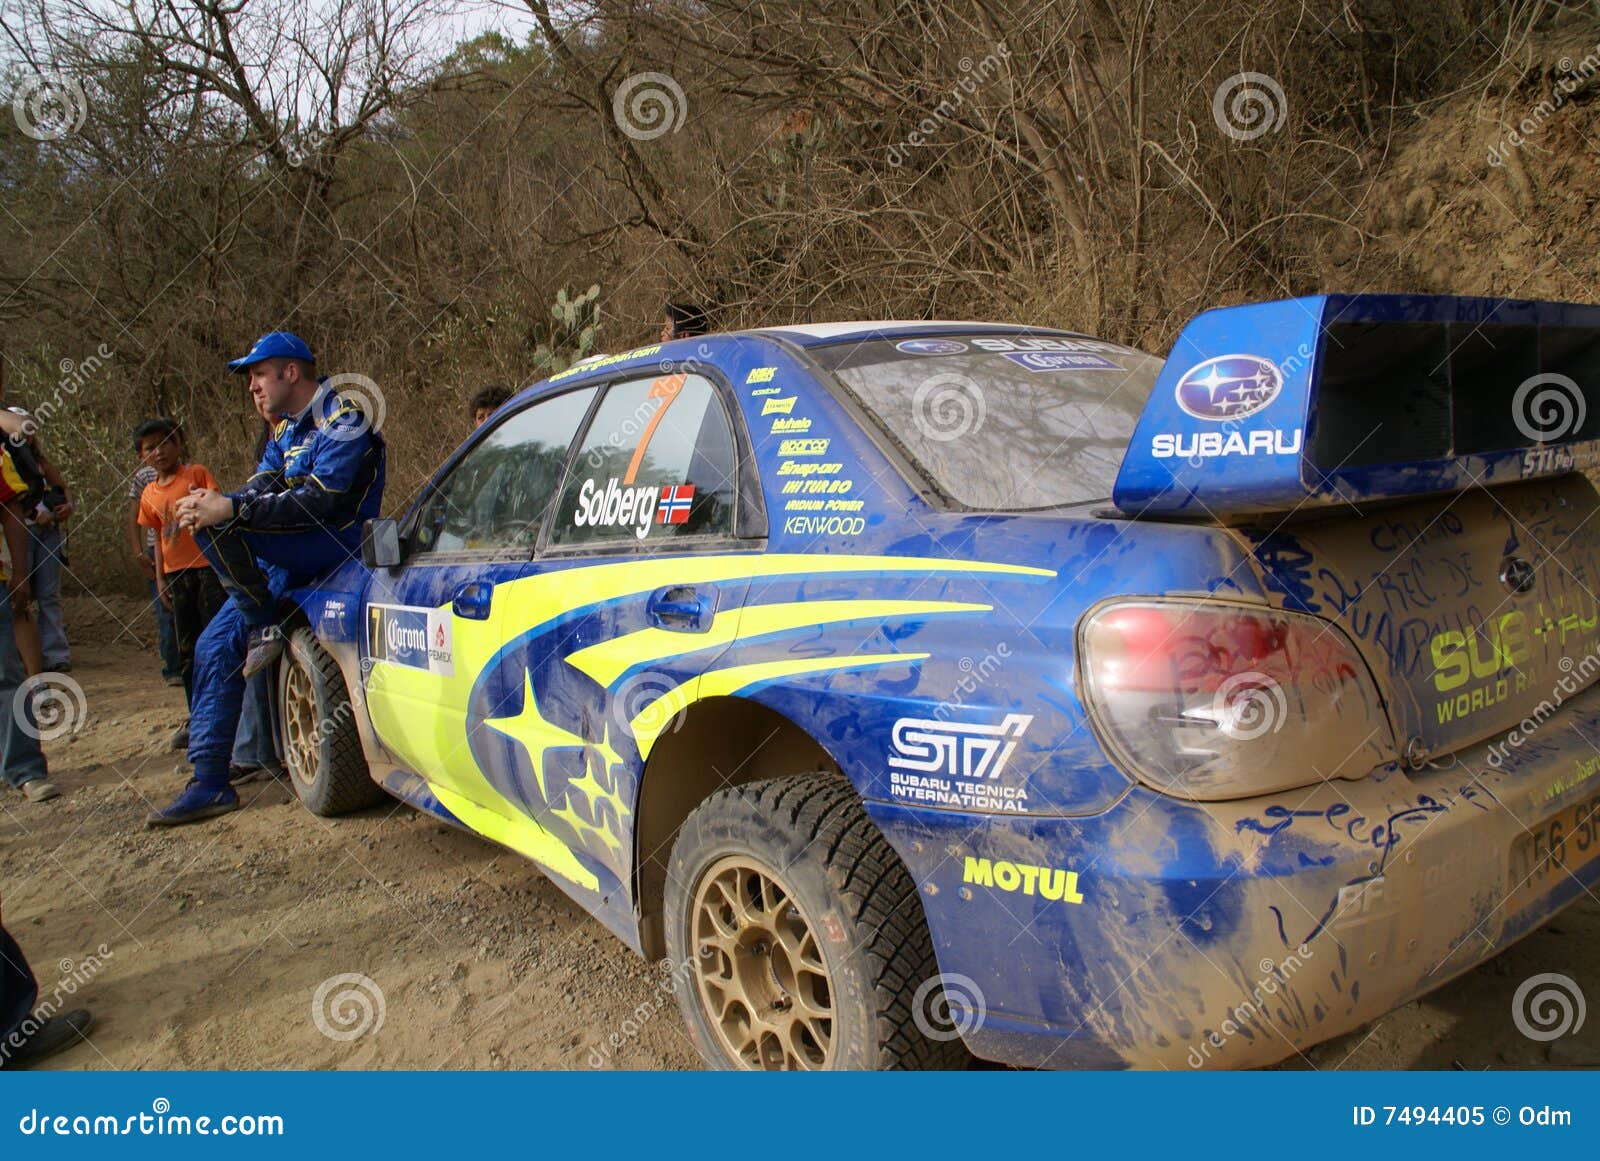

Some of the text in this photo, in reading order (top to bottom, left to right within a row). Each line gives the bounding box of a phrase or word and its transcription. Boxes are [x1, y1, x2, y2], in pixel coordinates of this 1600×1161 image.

[624, 373, 688, 485] 7
[1151, 428, 1302, 457] SUBARU
[802, 480, 853, 494] TURBO
[574, 477, 659, 539] Solberg
[825, 501, 864, 511] POWER
[783, 517, 865, 535] KENWOOD
[370, 607, 427, 657] 7 Corona
[1436, 679, 1508, 725] WORLD
[890, 773, 1028, 800] SUBARU TECNICA
[890, 784, 1029, 813] INTERNATIONAL
[962, 856, 1084, 904] MOTUL
